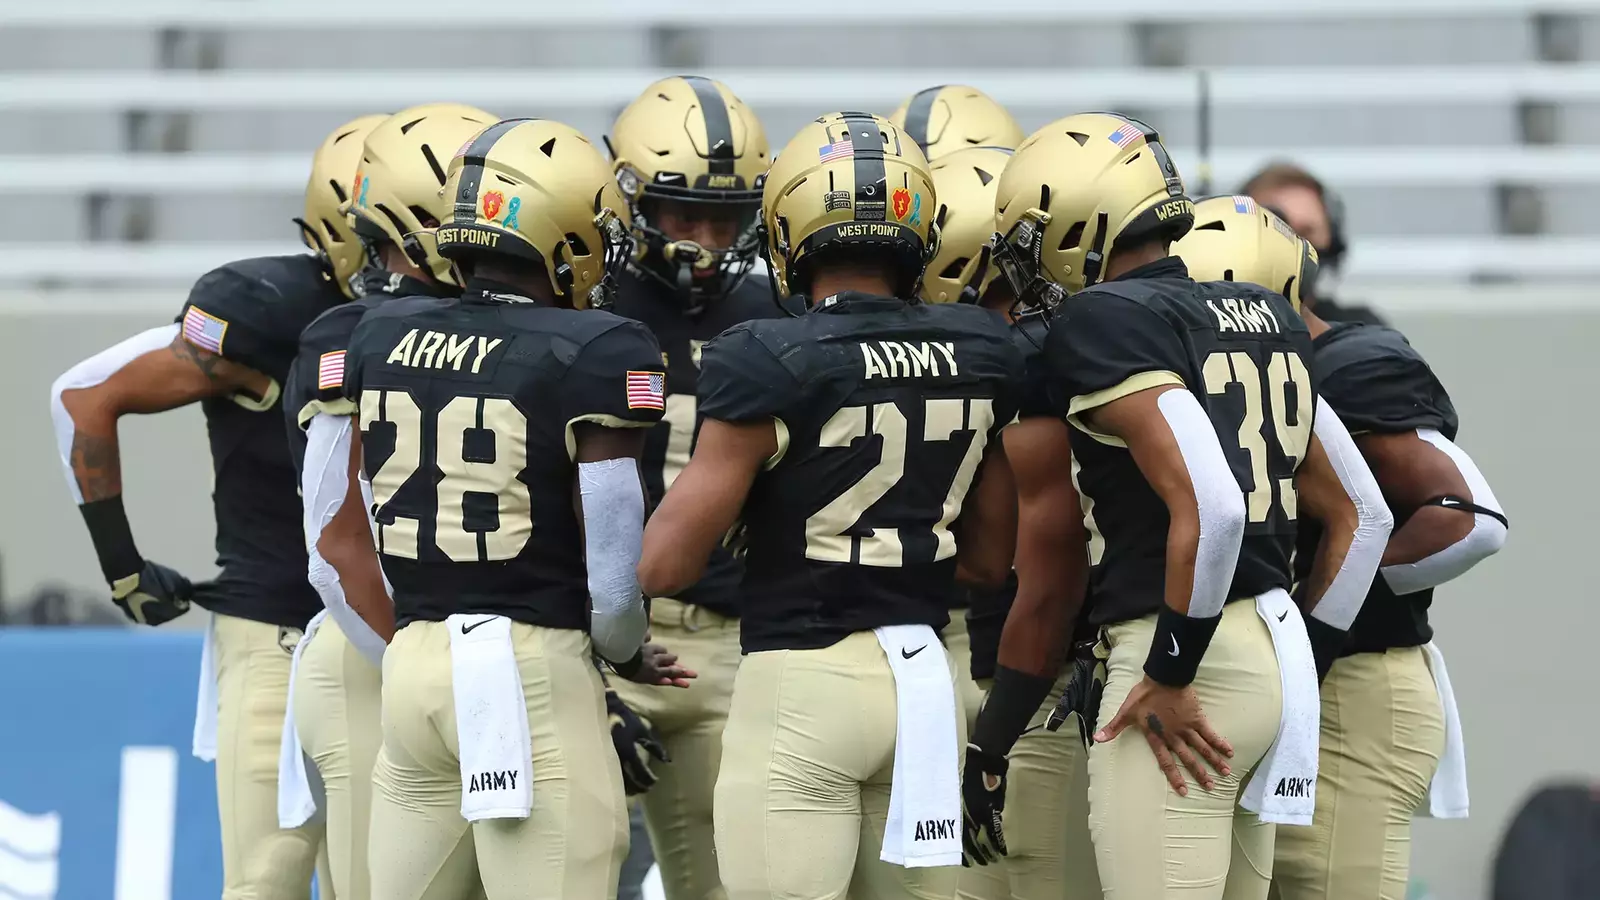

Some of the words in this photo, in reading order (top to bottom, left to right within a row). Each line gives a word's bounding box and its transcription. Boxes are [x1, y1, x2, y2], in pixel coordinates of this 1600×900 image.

[708, 175, 736, 188] ARMY
[1154, 200, 1185, 221] WEST
[461, 228, 500, 247] POINT
[837, 224, 868, 237] WEST
[870, 224, 900, 238] POINT
[1206, 298, 1281, 333] ARMY
[386, 328, 503, 374] ARMY
[859, 340, 959, 379] ARMY
[1202, 352, 1313, 522] 39
[359, 390, 533, 562] 28
[805, 398, 995, 567] 27
[469, 770, 518, 793] ARMY
[1274, 777, 1313, 798] ARMY
[914, 819, 956, 842] ARMY
